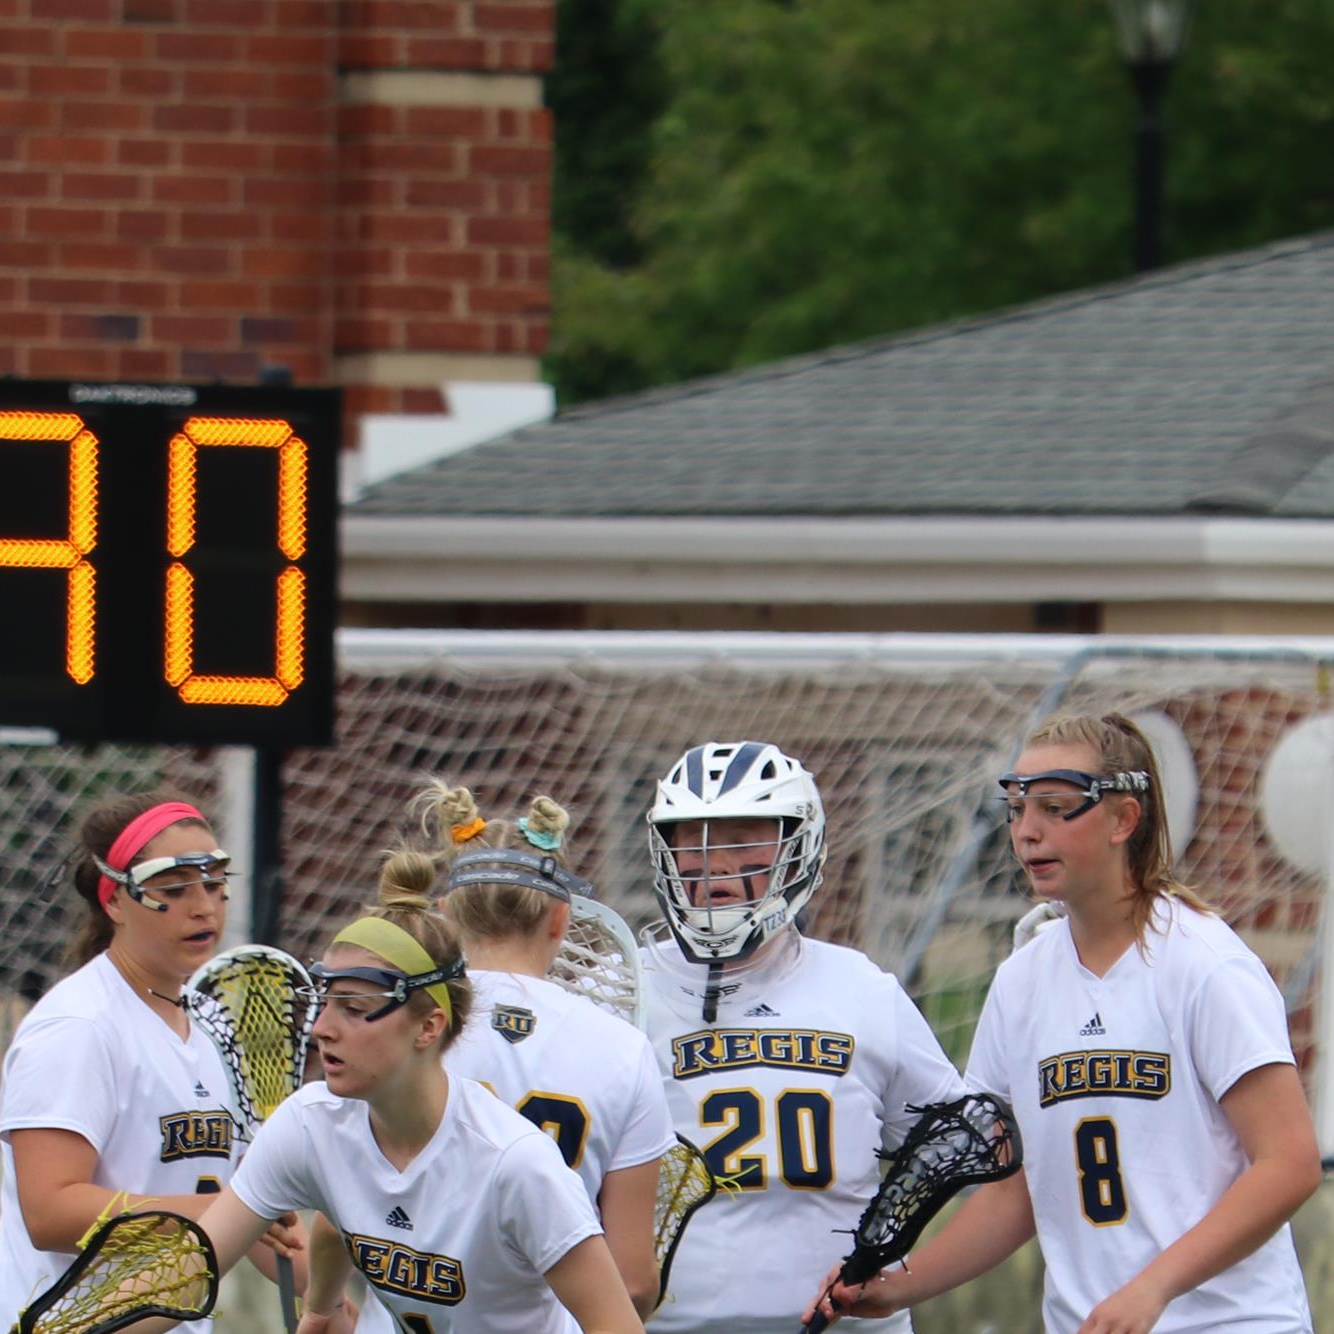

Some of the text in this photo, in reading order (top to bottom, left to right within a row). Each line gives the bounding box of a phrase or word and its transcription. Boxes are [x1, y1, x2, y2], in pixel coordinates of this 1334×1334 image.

[672, 1028, 855, 1081] REGIS
[1038, 1049, 1171, 1109] REGIS
[159, 1110, 232, 1163] REGI
[700, 1086, 837, 1192] 20
[1073, 1115, 1131, 1228] 8
[342, 1229, 466, 1307] EGIS
